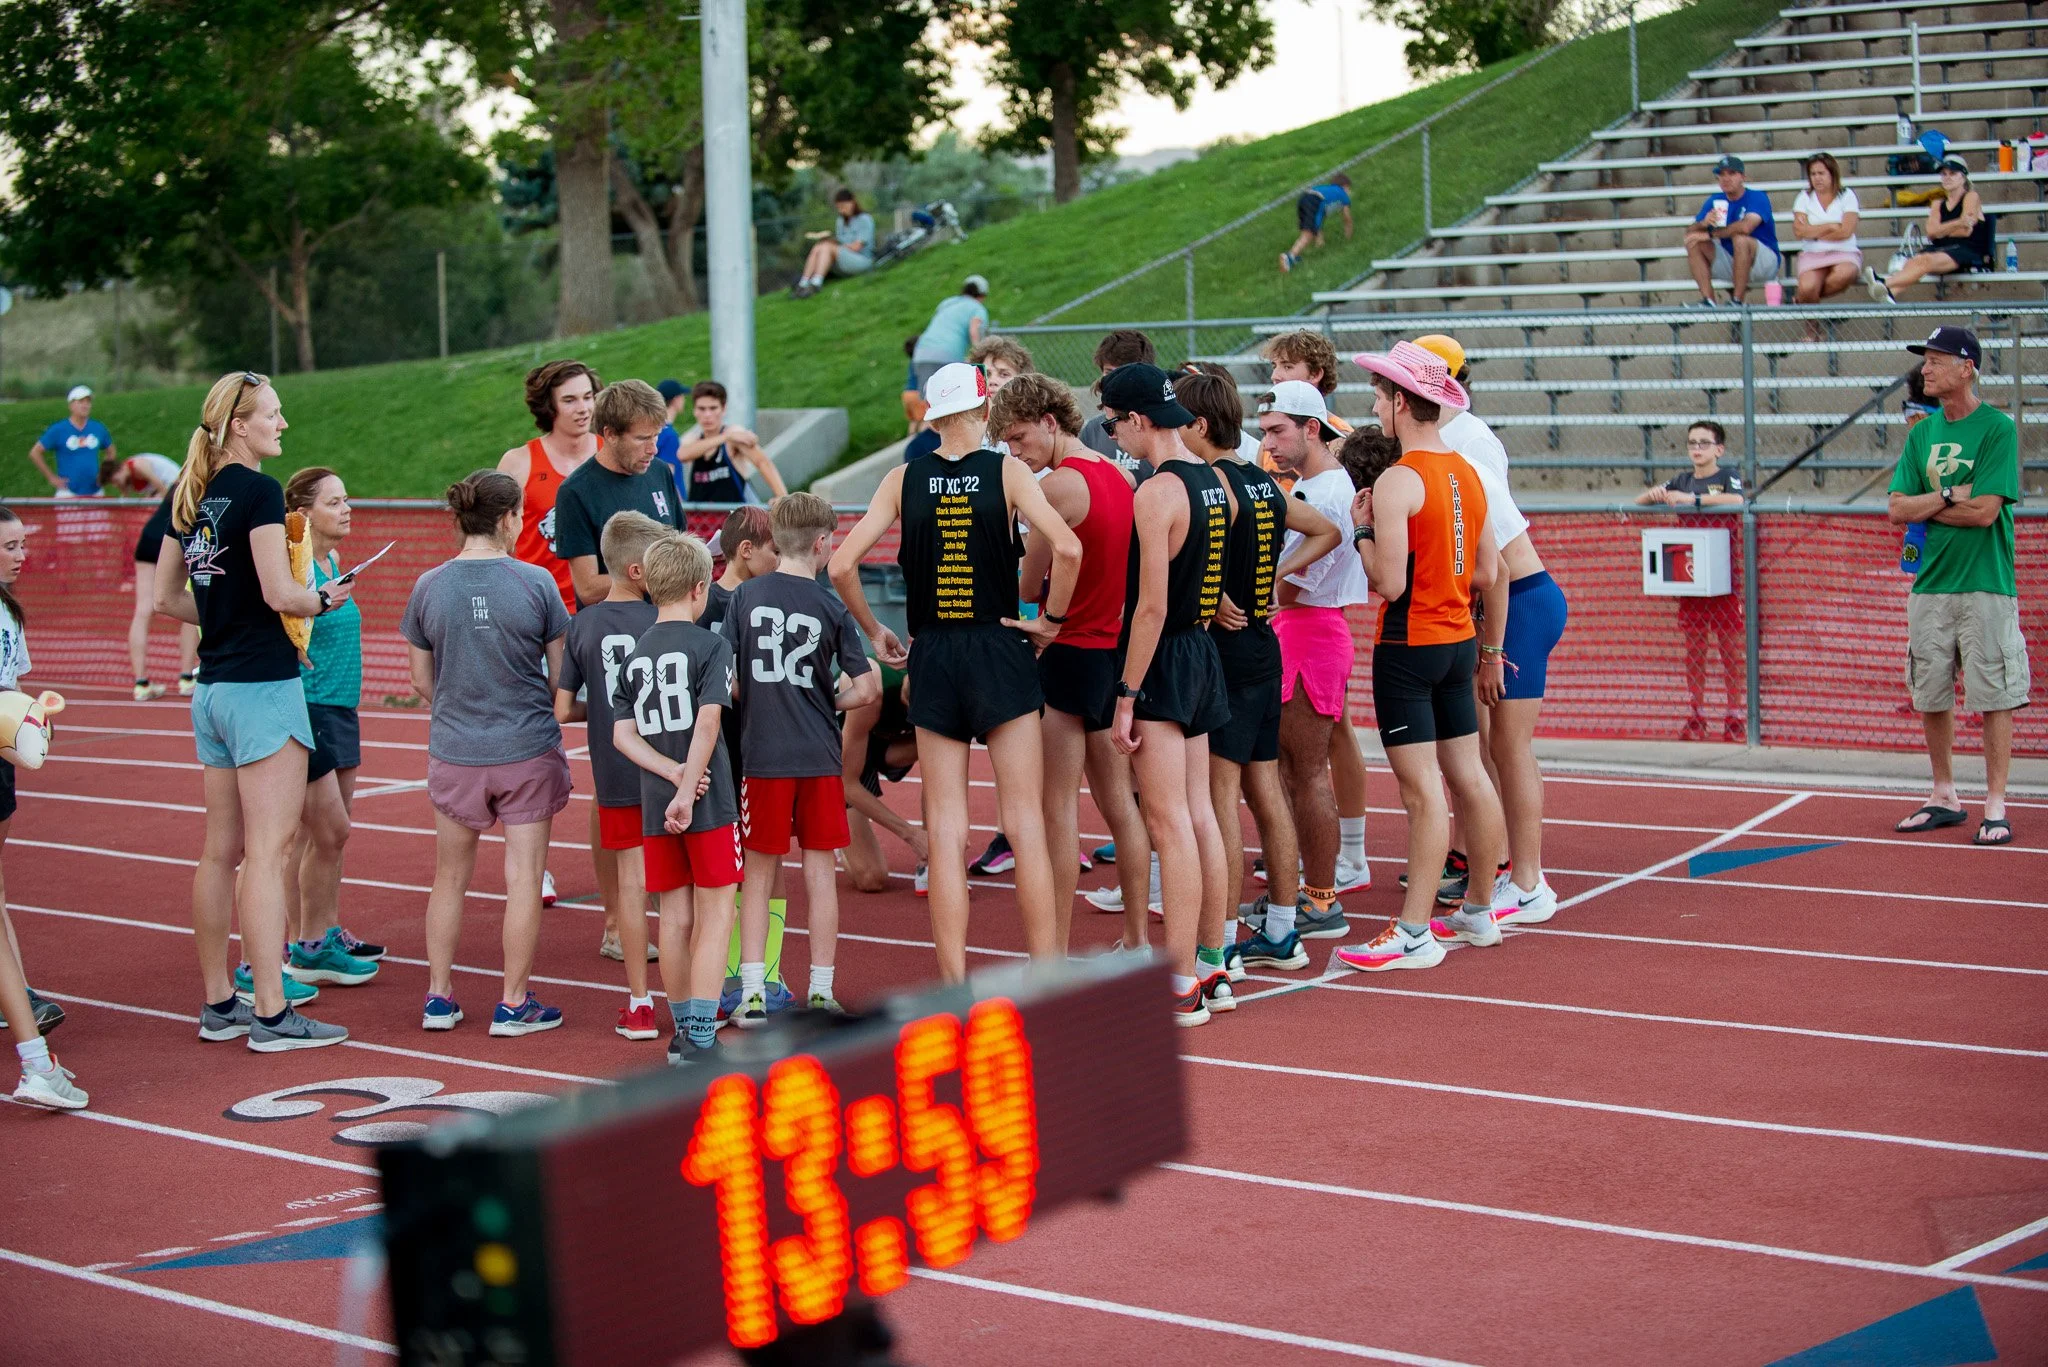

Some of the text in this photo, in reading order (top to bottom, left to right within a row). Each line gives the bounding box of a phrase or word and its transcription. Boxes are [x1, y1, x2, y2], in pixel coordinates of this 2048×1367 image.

[929, 475, 980, 494] BT XC '22
[1449, 473, 1464, 575] LAKEWOOD
[941, 529, 957, 540] Timmy
[943, 541, 956, 550] John
[942, 553, 955, 562] Jack
[471, 596, 489, 609] COL
[473, 609, 489, 620] FAX
[750, 605, 822, 688] 32
[626, 651, 694, 737] 28
[681, 997, 1039, 1347] 13:59
